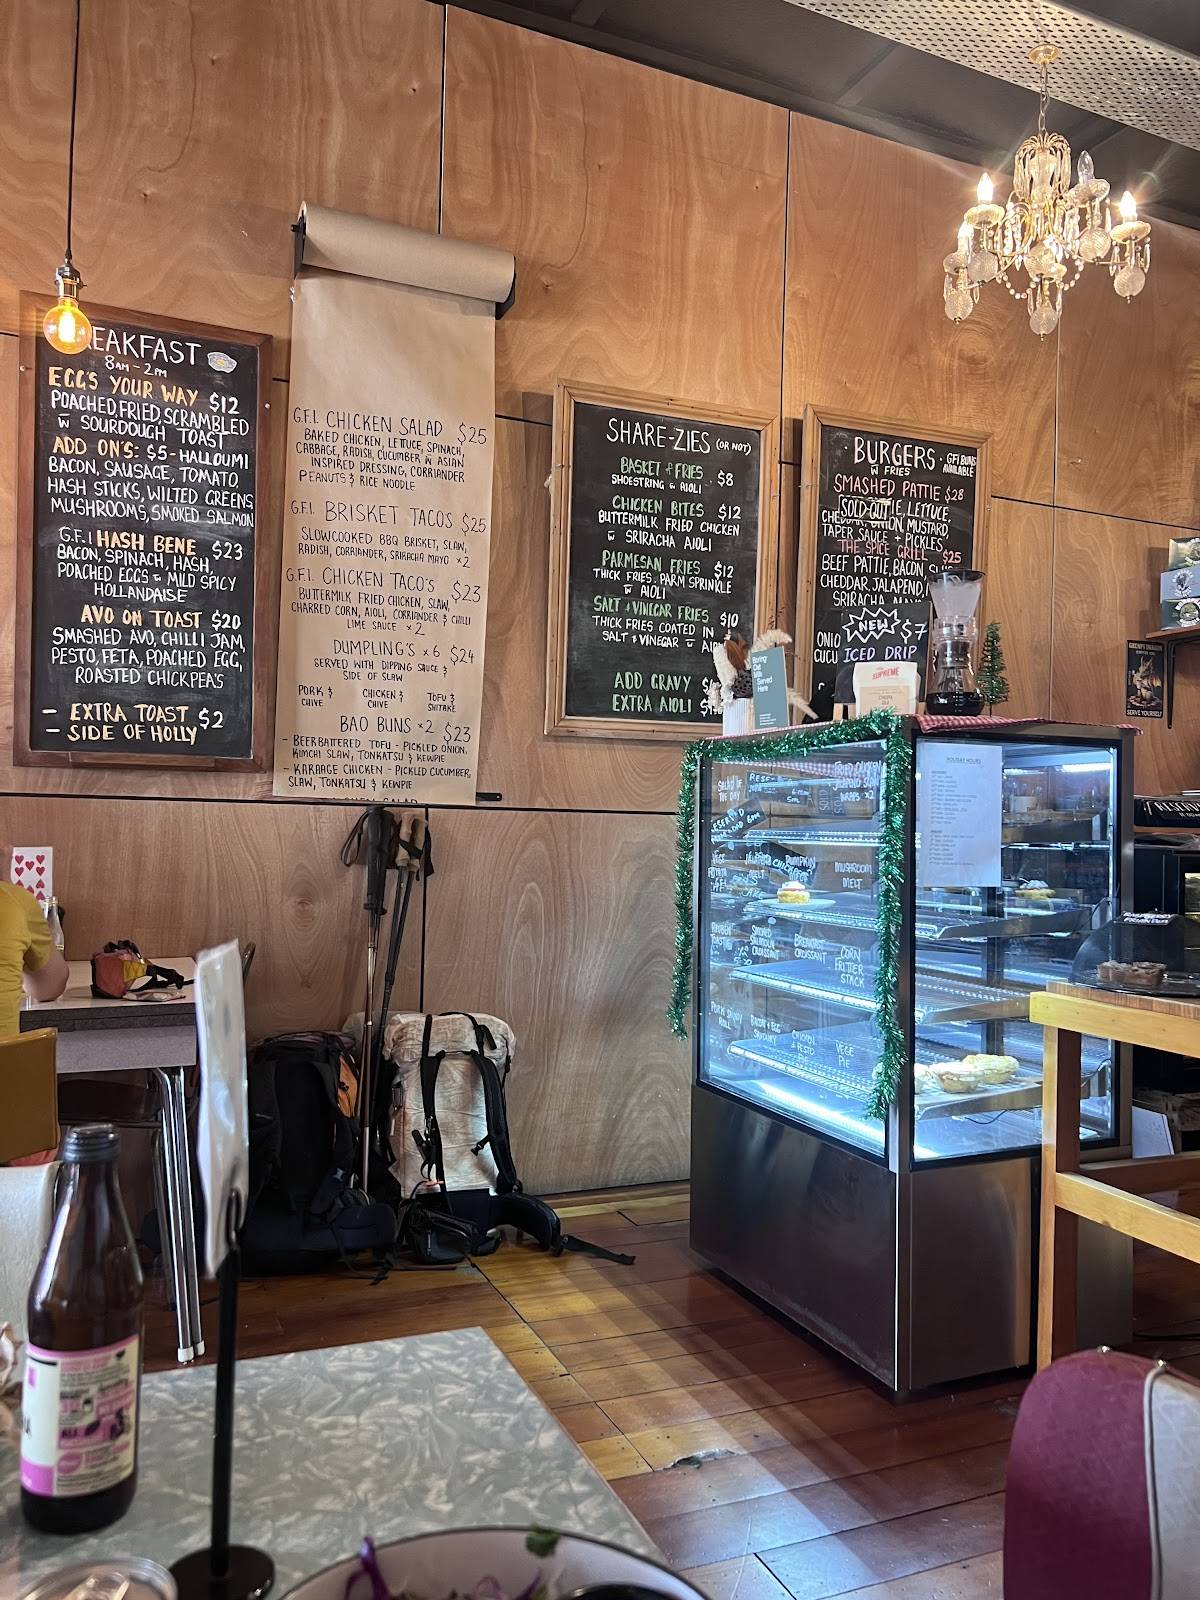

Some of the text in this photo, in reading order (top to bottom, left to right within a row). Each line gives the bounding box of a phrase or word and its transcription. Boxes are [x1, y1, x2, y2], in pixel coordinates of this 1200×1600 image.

[86, 326, 201, 365] EAKFAST
[111, 376, 239, 414] YOUR WAY $12
[81, 415, 227, 449] SOURDOUGH TOAST
[164, 411, 249, 436] SCRAMBLED
[326, 411, 487, 445] CHICKEN SALAD $25
[53, 436, 87, 454] ADD
[304, 428, 338, 443] BAKED
[606, 418, 710, 454] SHARE-ZIES
[378, 450, 464, 468] CUCUMBER ASIAN
[854, 436, 935, 470] BURGERS
[49, 457, 174, 483] BACON, SAUSAGE,
[311, 457, 465, 482] INSPIRED CORRIANDER
[621, 457, 734, 487] BASKET FRIES $8
[884, 464, 974, 477] FRIES AVAILABLE
[48, 477, 198, 504] HASH STICKS, WILTED
[299, 470, 415, 491] PEANUTS RICE NOODLE
[834, 473, 964, 502] SMASHED PATTIE $28
[151, 504, 254, 527] SMOKED SALMON
[612, 495, 741, 521] CHICKEN BITES $12
[908, 502, 951, 522] LETTUCE,
[325, 501, 486, 536] BRISKET $25
[599, 510, 739, 536] BUTTERMILK FRIED CHICKEN
[96, 530, 243, 560] HASH BENE $23
[301, 527, 399, 546] SLOWCOOKED BBQ
[684, 537, 711, 552] AIOLI
[822, 524, 943, 551] TAPER SAUCE PICKLES
[57, 544, 169, 571] BACON, SPINACH,
[390, 550, 449, 564] SRIRACHA MAYO
[838, 540, 961, 564] THE SPICE GRILL $25
[602, 550, 734, 579] PARMESAN FRIES $12
[822, 554, 849, 571] BEEF
[58, 562, 237, 591] POACHED EGGS MILD SPICY
[322, 567, 481, 604] CHICKEN $23
[593, 568, 732, 594] THICK SPRINKLE
[95, 582, 188, 603] HOLLANDAISE
[299, 587, 384, 605] BUTTERMILK FRIED
[641, 585, 665, 599] AIOLI
[81, 604, 241, 631] AVO ON TOAST $20
[291, 602, 471, 625] CHARRED CORRIANDER CHILLI
[594, 595, 739, 628] SALT FRIES $10
[347, 620, 397, 631] LIME SAUCE
[592, 615, 714, 637] THICK FRIES COATED IN
[858, 619, 927, 644] NEW $7
[53, 627, 204, 647] SMASHED CHILLI
[602, 631, 628, 642] SALT
[146, 650, 206, 668] POACHED
[450, 645, 474, 665] $24
[843, 646, 917, 662] ICED DRIP
[75, 667, 140, 684] ROASTED
[314, 658, 438, 673] SERVED WITH DIPPING SAUCE
[872, 667, 900, 680] SUPREME
[344, 671, 403, 682] SIDE OF SLAW
[614, 672, 642, 689] ADD
[299, 685, 324, 696] PORK
[362, 688, 396, 700] CHICKEN
[427, 692, 446, 701] TOFU
[367, 700, 388, 708] CHIVE
[612, 695, 651, 712] EXTRA
[70, 703, 224, 729] EXTRA TOAST $2
[67, 724, 197, 745] SIDE OF HOLLY
[340, 715, 471, 745] BAO BUNS $23
[369, 739, 437, 753] TOFU PICKLED
[358, 750, 445, 763] TONKATSU KEWPIE
[343, 764, 427, 776] CHICKEN PICKLED
[321, 778, 412, 790] TONKATSU KEWPIE
[841, 946, 860, 962] CORN
[835, 957, 864, 977] FRITTER
[841, 974, 864, 988] STACK
